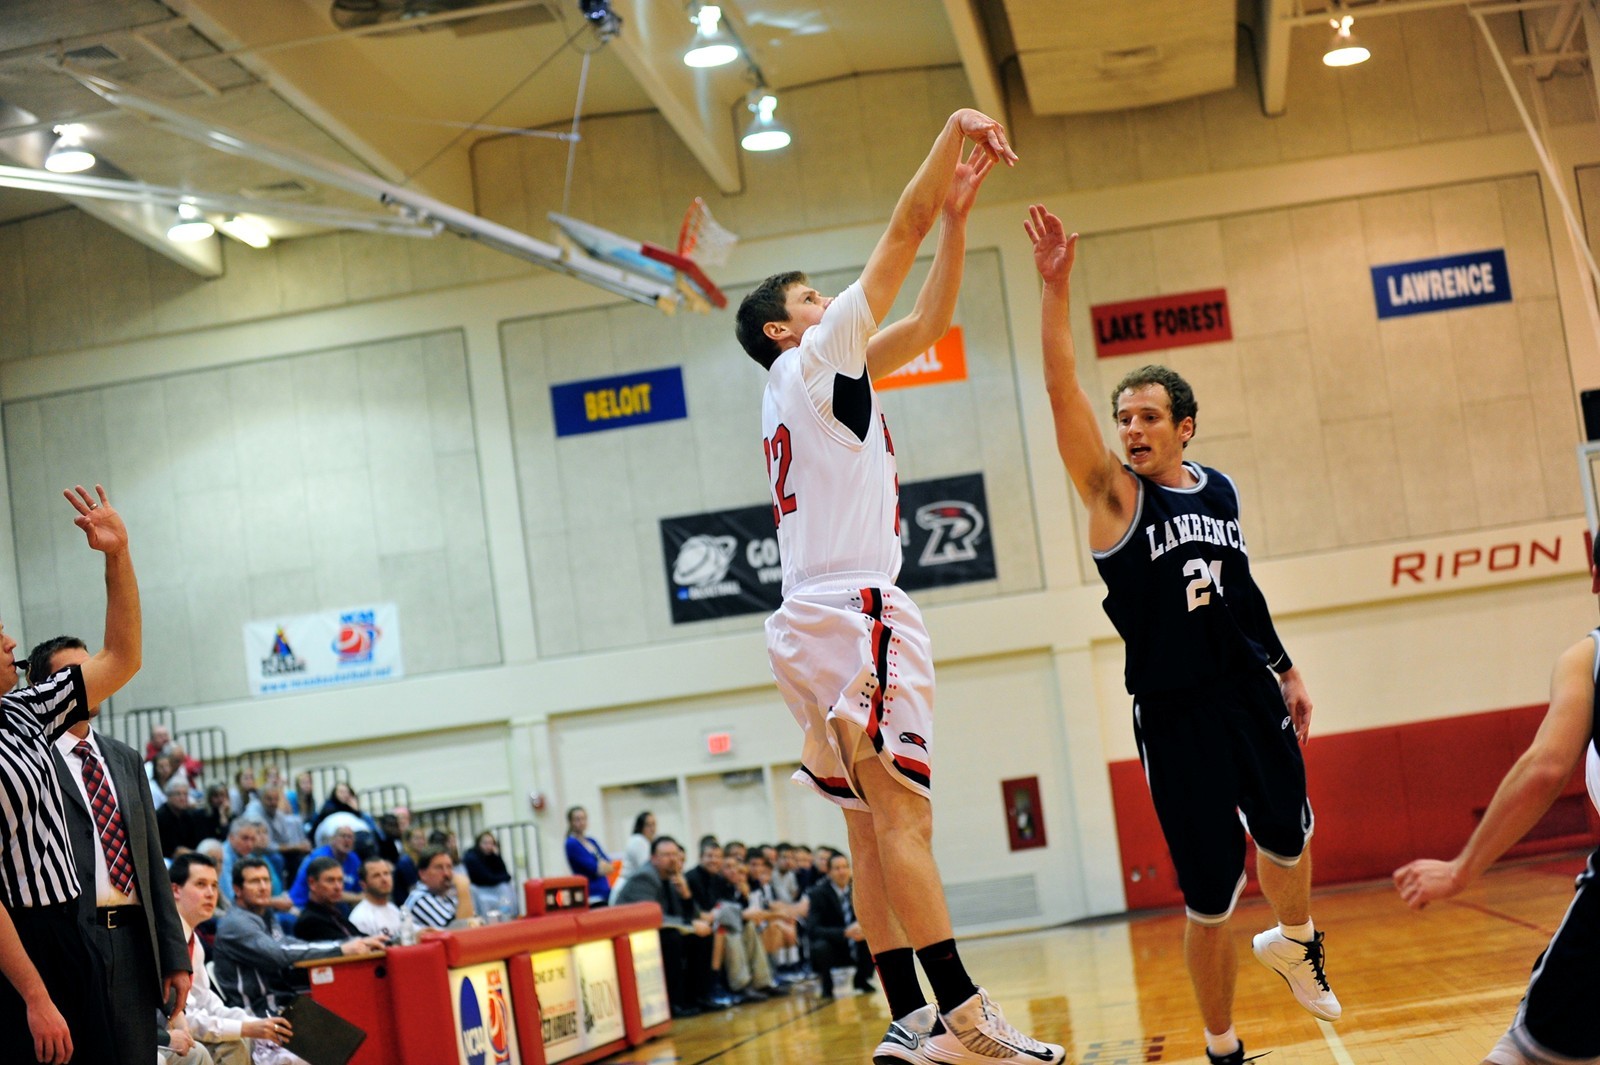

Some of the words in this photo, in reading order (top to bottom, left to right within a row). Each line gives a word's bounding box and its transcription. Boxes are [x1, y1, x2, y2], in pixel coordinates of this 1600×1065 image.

[1387, 262, 1496, 307] LAWRENCE
[1097, 312, 1146, 345] LAKE
[1152, 300, 1224, 337] FOREST
[584, 383, 652, 422] BELOIT
[1392, 536, 1562, 587] RIPON
